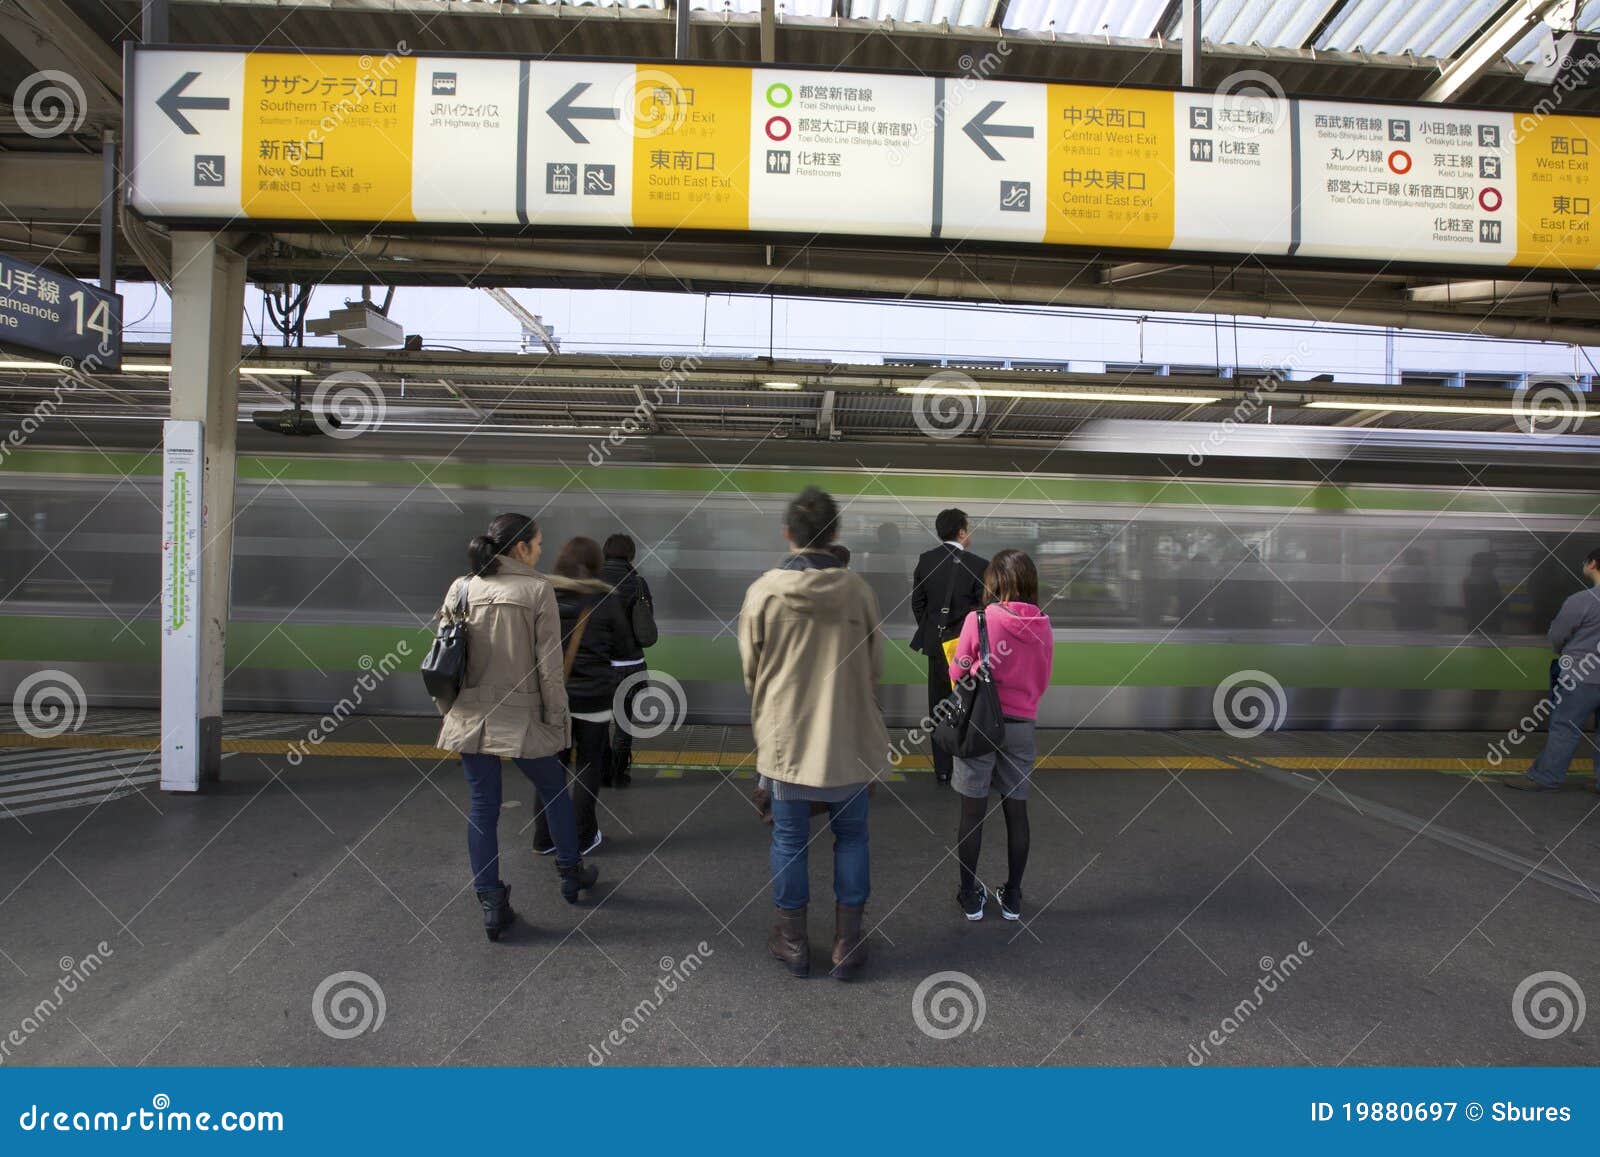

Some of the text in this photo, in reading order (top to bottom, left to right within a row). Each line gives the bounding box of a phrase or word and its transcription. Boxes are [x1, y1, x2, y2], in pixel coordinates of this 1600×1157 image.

[261, 75, 397, 96] サザンテラス口
[799, 85, 873, 102] 都営新宿線
[652, 86, 695, 106] 南口
[260, 99, 397, 115] Southern Terrace Exit
[799, 101, 876, 112] Toei Shinjuku Line
[651, 108, 715, 123] South Exit
[1063, 106, 1146, 128] 中央西口
[1314, 114, 1382, 131] 西武新宿線
[430, 119, 500, 129] JR Highway Bus
[1420, 121, 1473, 137] 小田急線
[1063, 129, 1157, 145] Central West Exit
[1457, 138, 1473, 147] Line
[259, 139, 324, 160] 新南口
[1218, 140, 1260, 156] 化粧室
[1551, 135, 1588, 156] 西口
[650, 149, 715, 171] 東南口
[797, 151, 841, 166] 化粧室
[1218, 156, 1261, 166] Restrooms
[1330, 147, 1384, 163] 丸ノ内線
[1433, 153, 1474, 168] 京王線
[258, 165, 354, 178] New South Exit
[796, 167, 842, 177] Restrooms
[1536, 157, 1588, 171] West Exit
[648, 174, 732, 188] South East Exit
[1063, 168, 1146, 190] 中央東口
[1458, 170, 1474, 178] Line
[1062, 191, 1153, 208] Central East Exit
[1552, 195, 1590, 215] 東口
[1434, 217, 1474, 233] 化粧室
[1541, 217, 1589, 231] East Exit
[1433, 233, 1474, 243] Restrooms
[69, 290, 113, 351] 14
